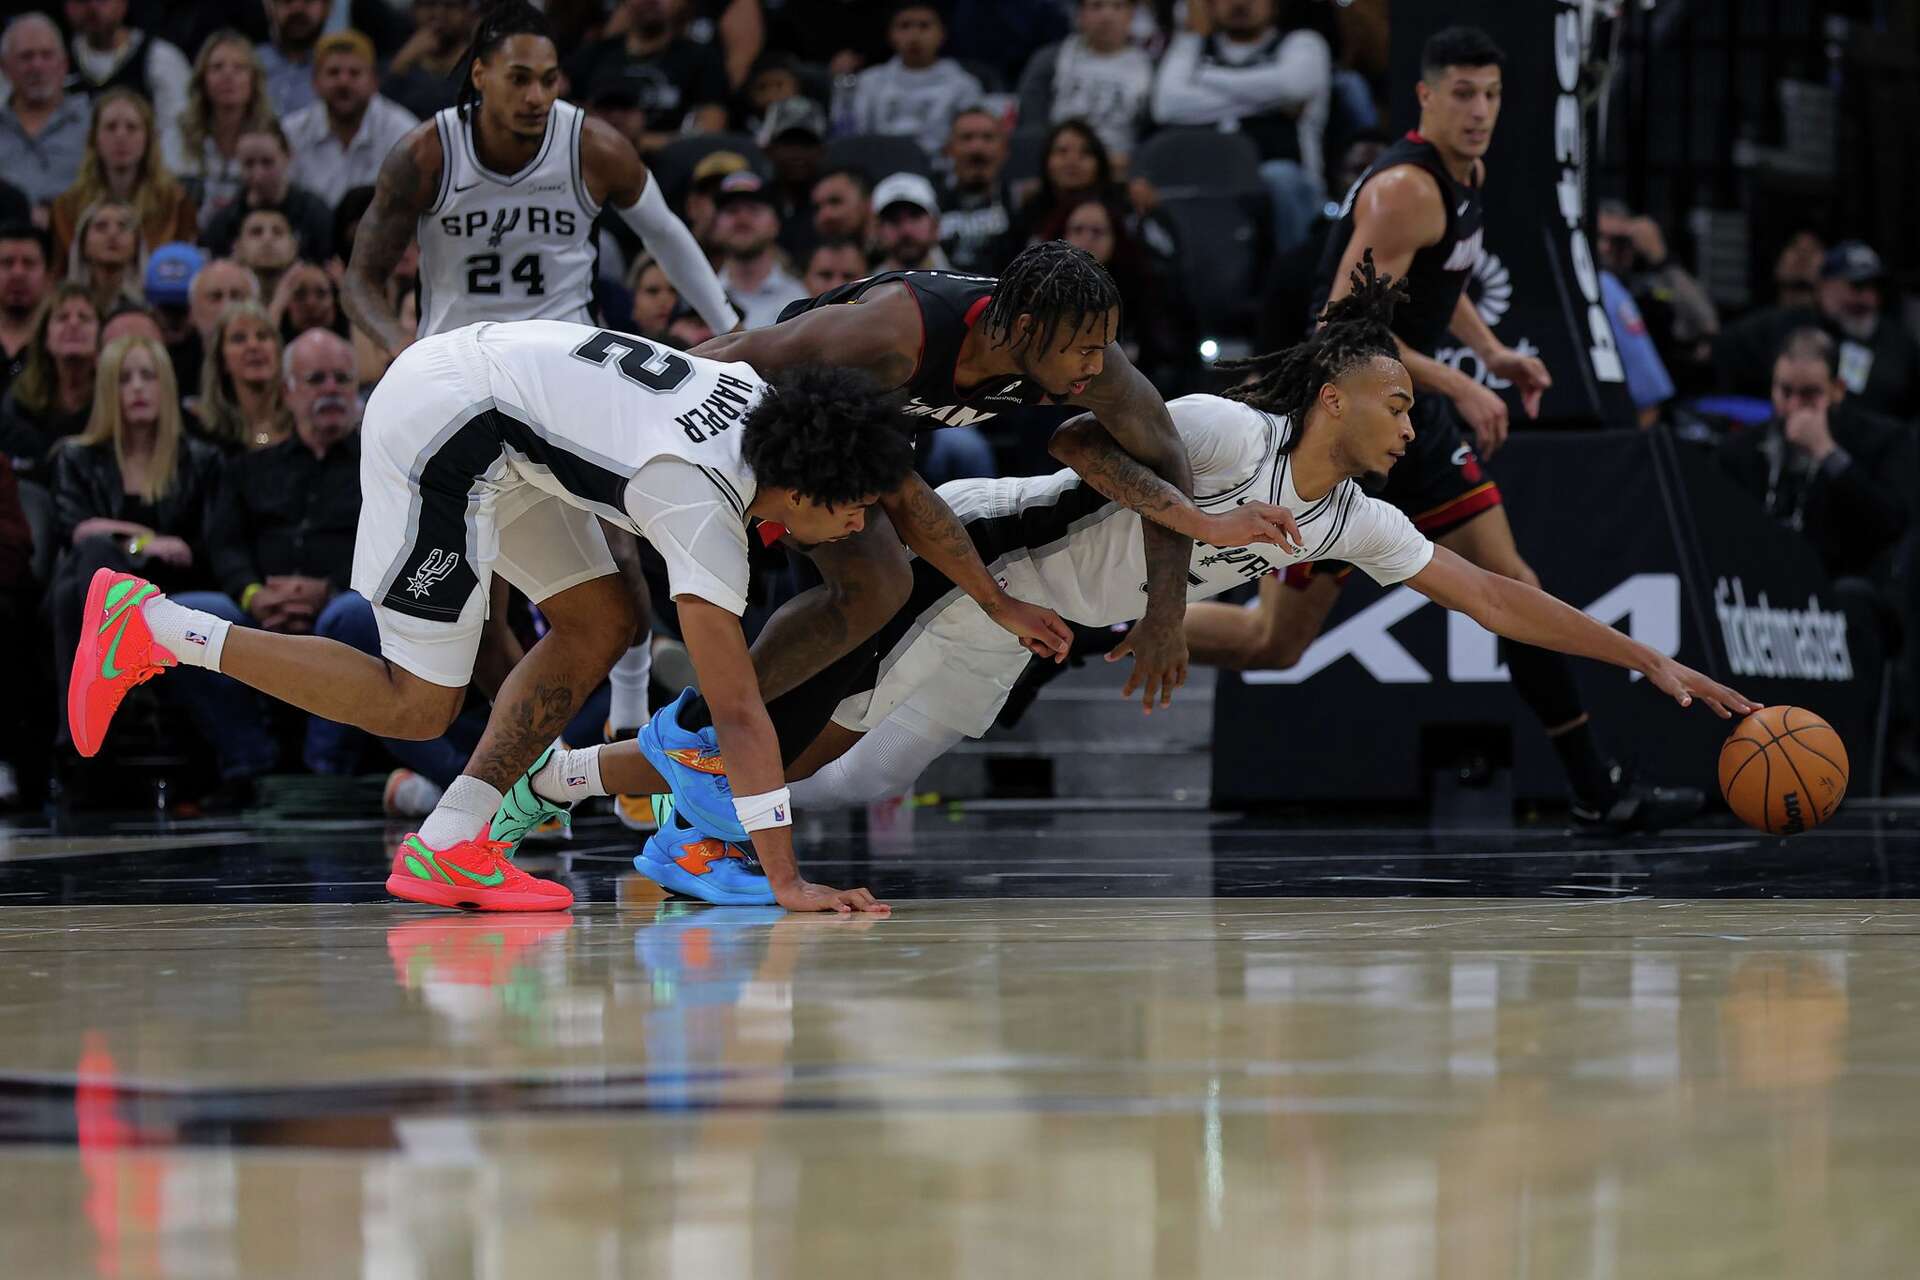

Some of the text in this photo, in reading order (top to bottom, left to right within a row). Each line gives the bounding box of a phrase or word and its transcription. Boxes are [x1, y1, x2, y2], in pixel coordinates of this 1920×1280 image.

[440, 206, 577, 248] SPURS
[466, 252, 546, 297] 24
[568, 328, 697, 396] 2
[674, 372, 754, 444] HARPER
